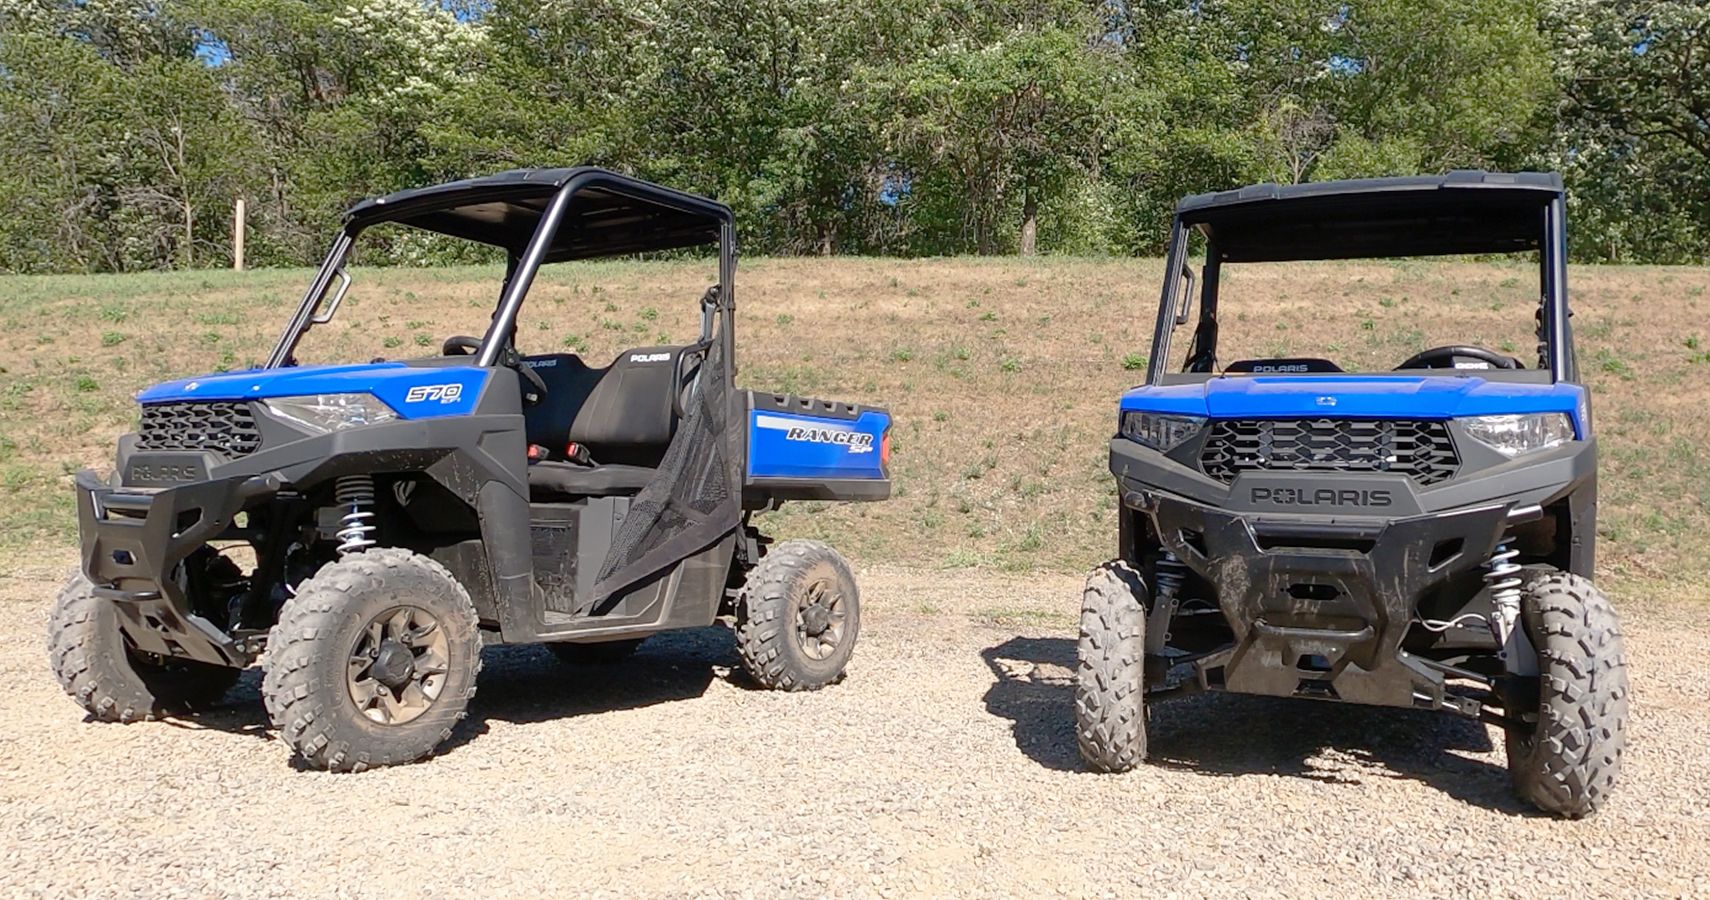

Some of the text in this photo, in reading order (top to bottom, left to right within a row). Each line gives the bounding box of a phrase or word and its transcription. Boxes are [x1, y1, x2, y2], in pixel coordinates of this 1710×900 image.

[630, 352, 671, 363] POLARIS
[1253, 364, 1308, 373] POLARIS
[405, 383, 463, 402] 570
[786, 426, 874, 446] RANGER
[1251, 487, 1392, 506] POLARIS
